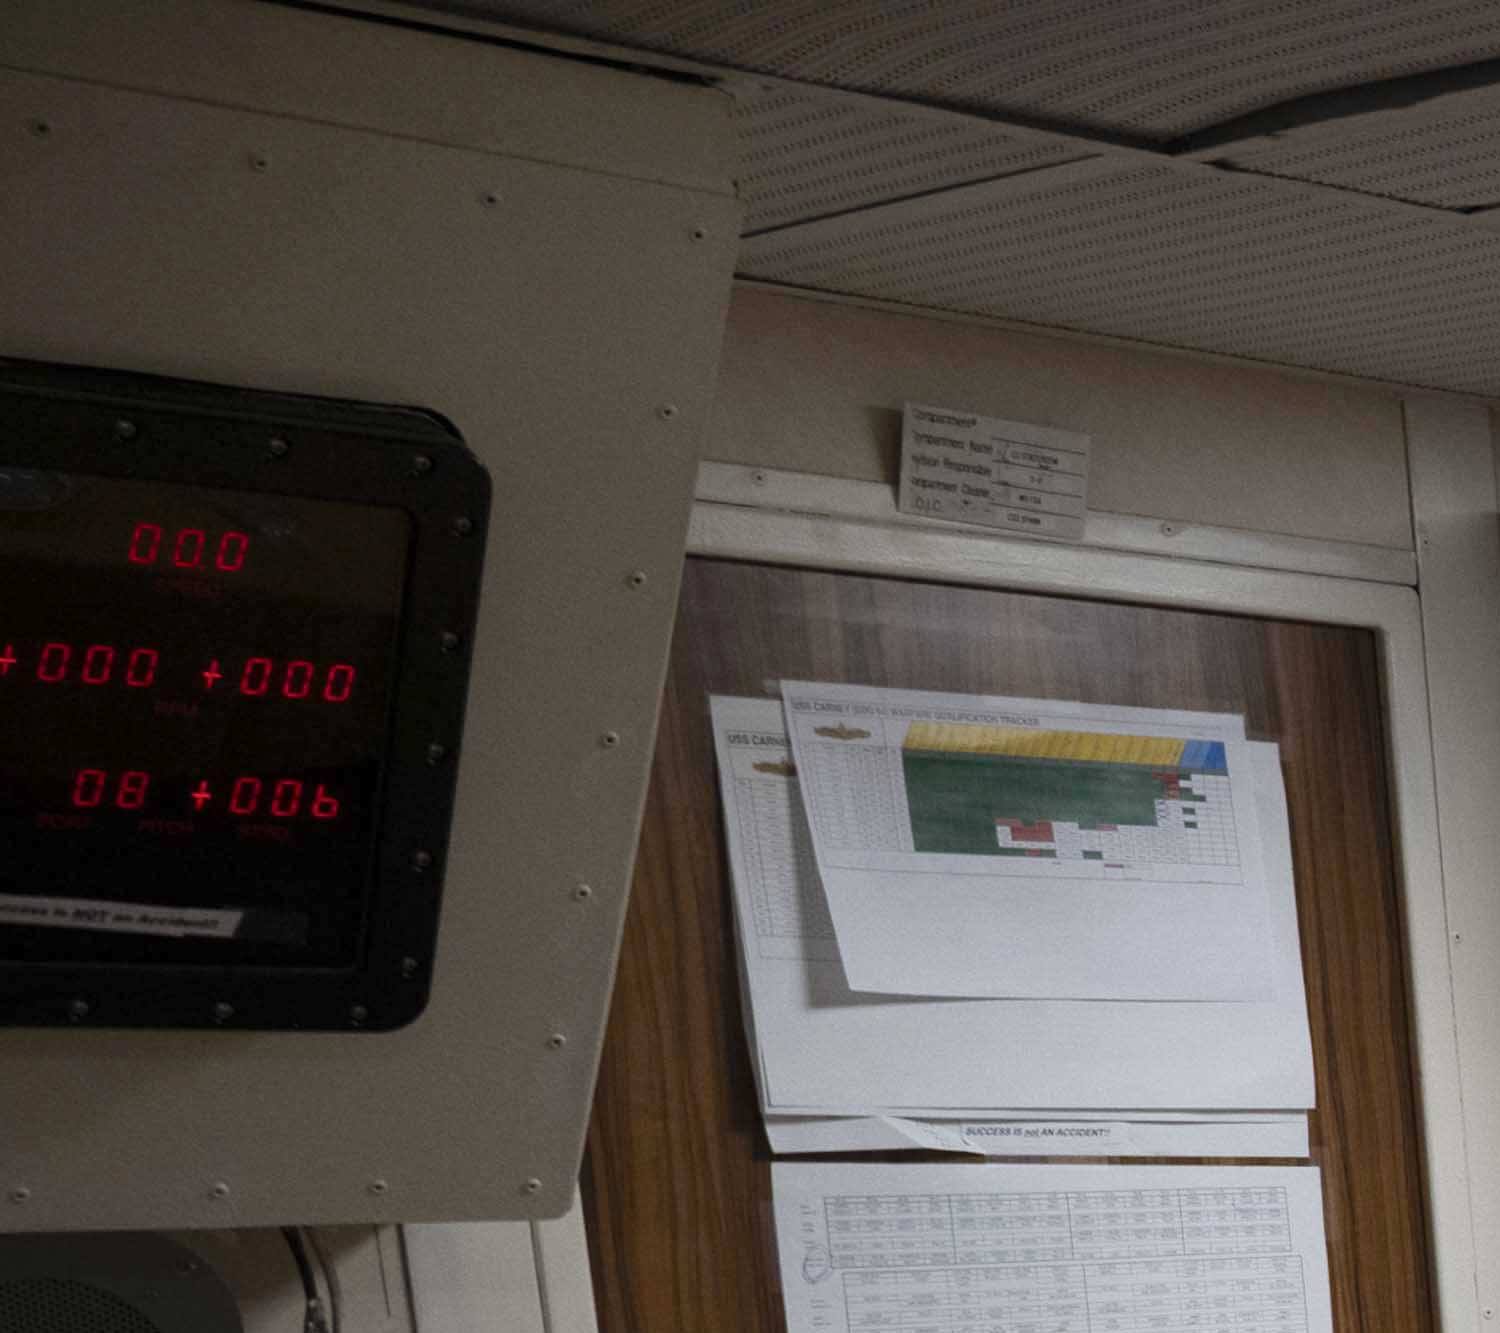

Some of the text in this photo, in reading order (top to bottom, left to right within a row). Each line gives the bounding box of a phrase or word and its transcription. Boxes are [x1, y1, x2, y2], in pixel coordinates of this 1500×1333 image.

[728, 732, 750, 745] USS
[965, 1126, 1012, 1137] SUCCESS
[1013, 1127, 1022, 1137] IS
[1041, 1127, 1054, 1137] AN
